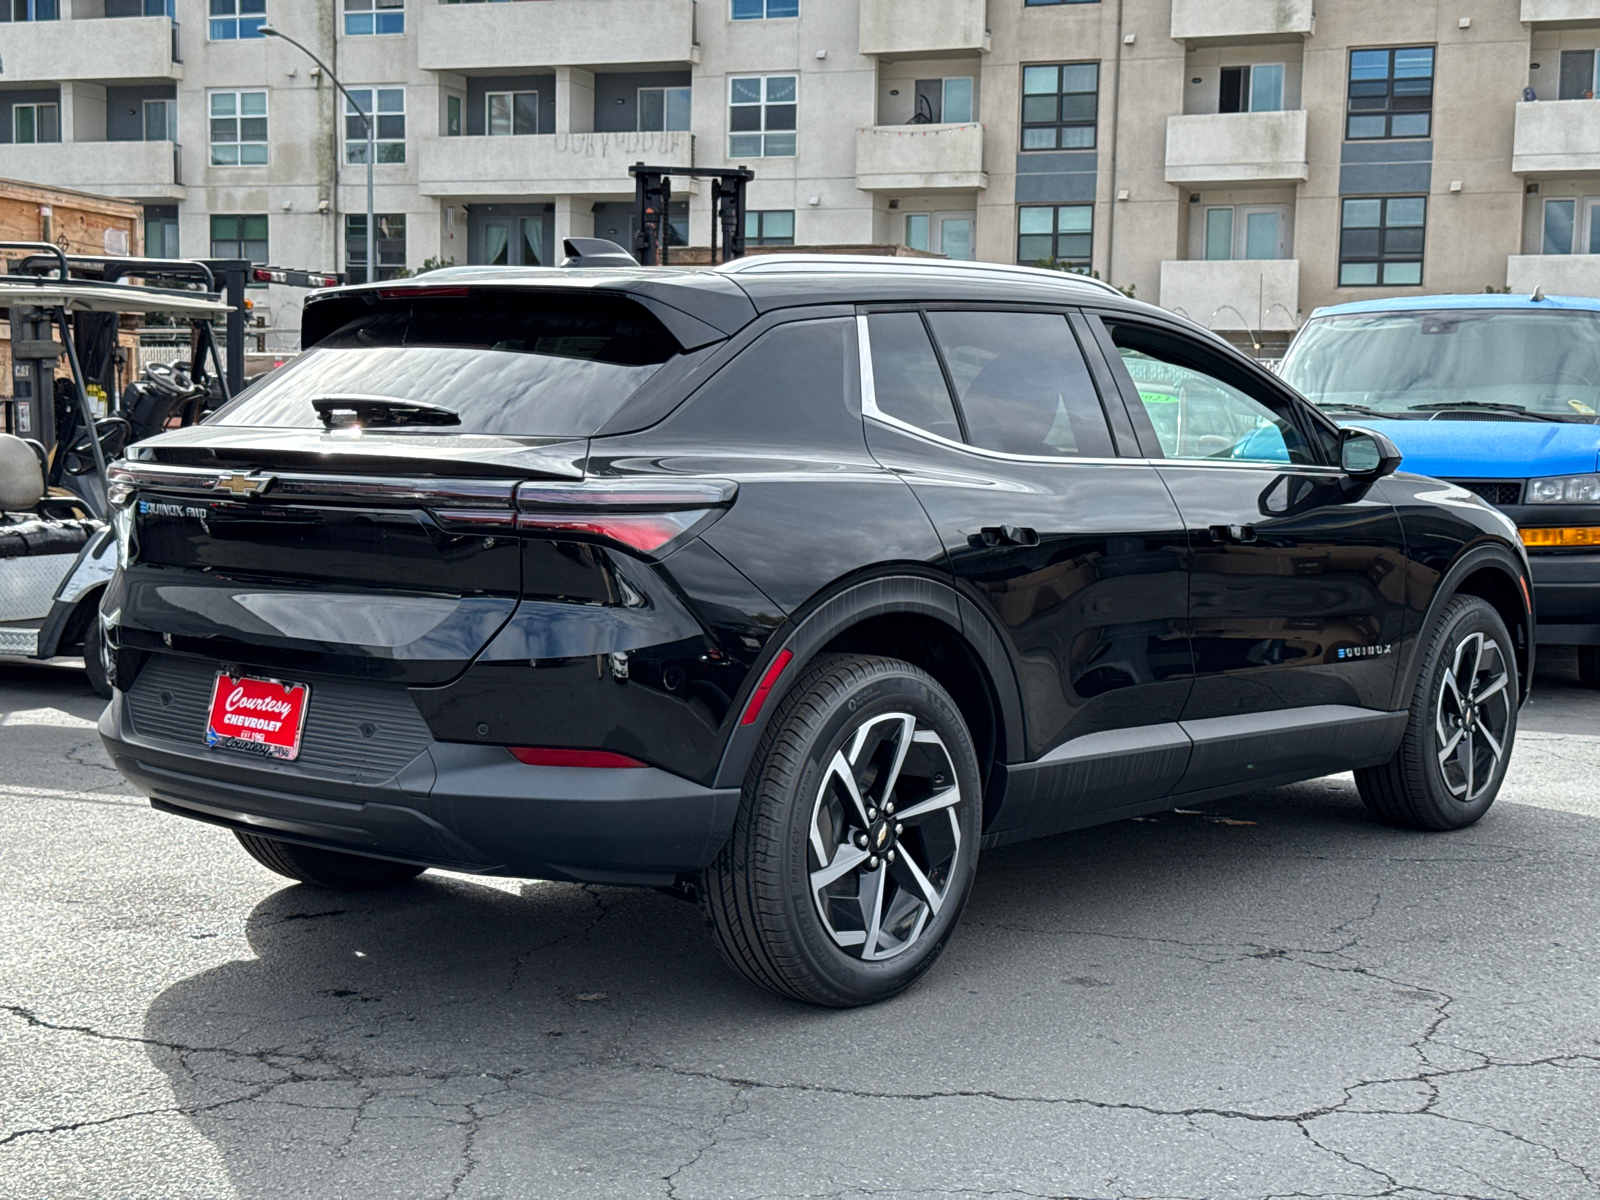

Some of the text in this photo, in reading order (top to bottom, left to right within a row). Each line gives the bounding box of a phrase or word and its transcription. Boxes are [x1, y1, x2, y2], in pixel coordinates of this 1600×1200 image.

[15, 365, 30, 377] CAT
[1337, 644, 1391, 659] EQUINOX
[225, 686, 292, 720] Courtesy
[223, 713, 282, 732] CHEVROLET
[791, 827, 800, 883] PRIMACY
[798, 767, 814, 804] SEASON
